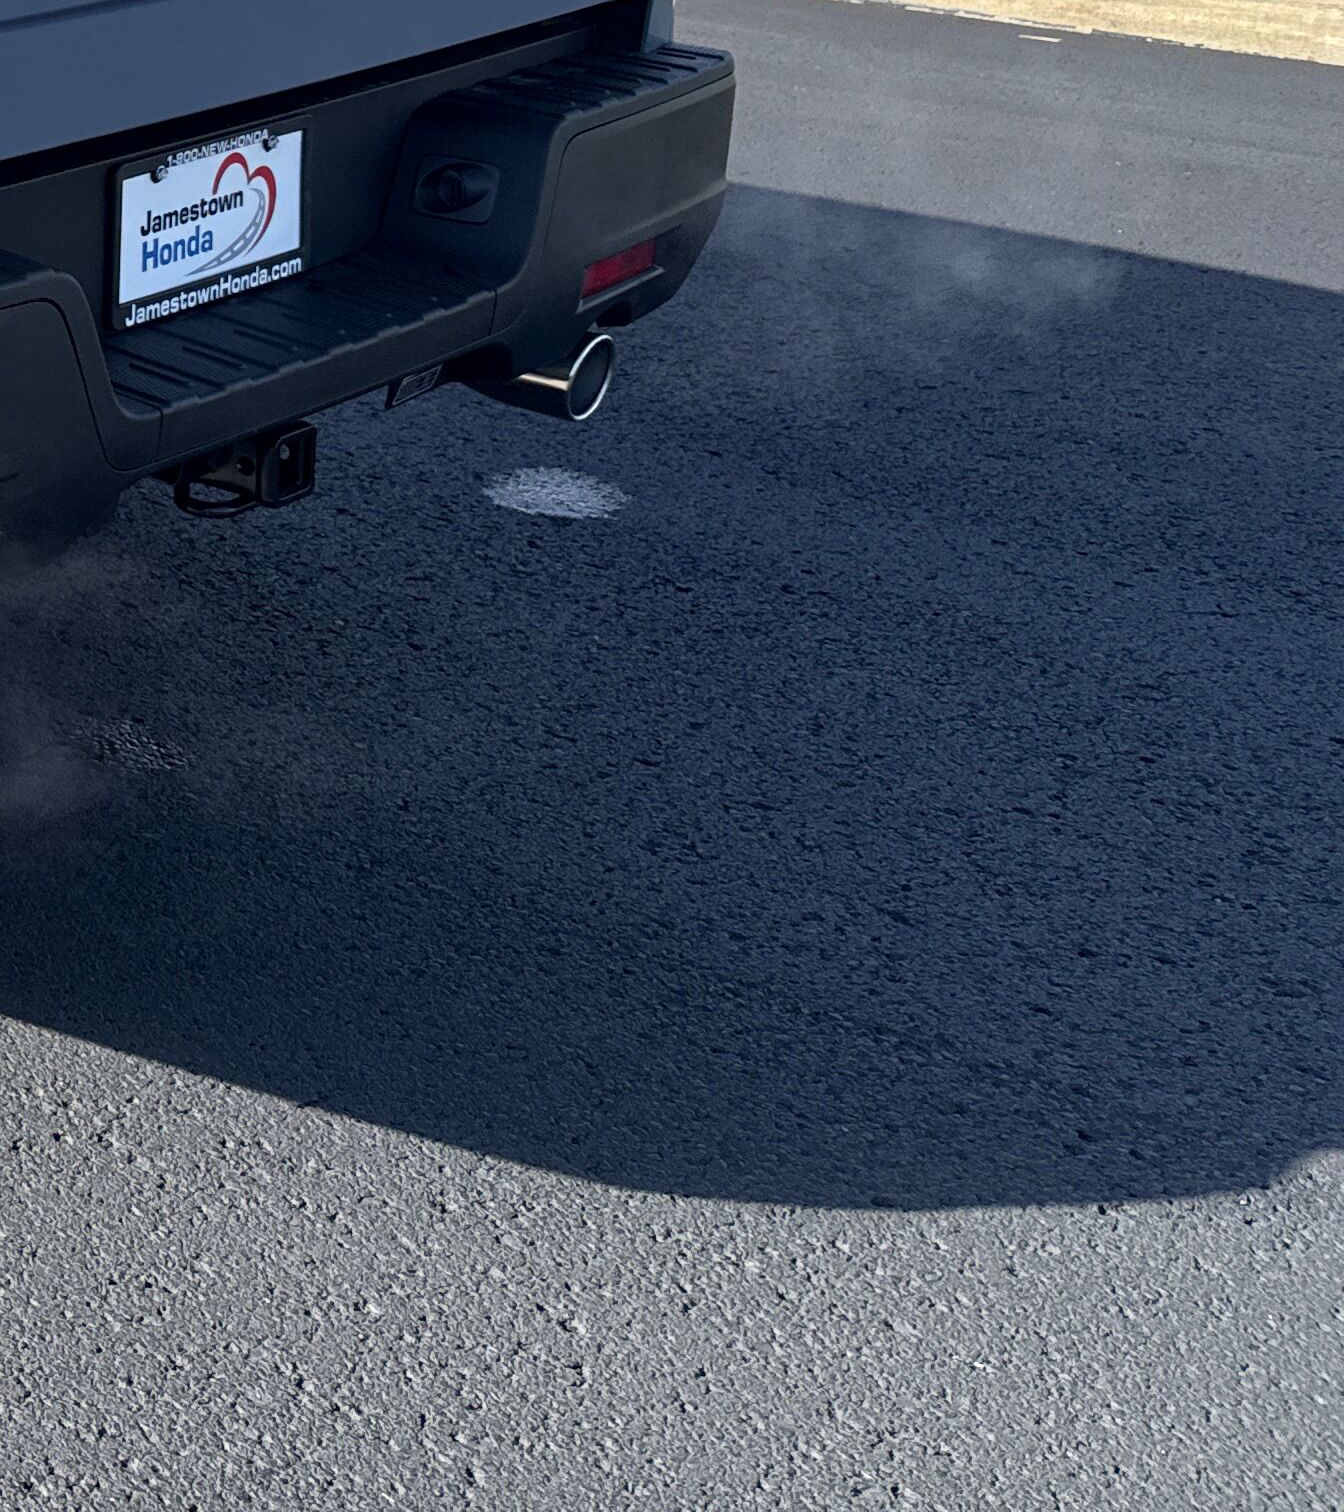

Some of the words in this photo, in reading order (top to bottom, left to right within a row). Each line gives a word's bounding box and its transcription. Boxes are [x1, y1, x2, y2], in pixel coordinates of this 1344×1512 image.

[166, 128, 269, 168] 1-800-NEW-HONDA
[140, 189, 244, 237] Jamestown
[141, 225, 214, 273] Honda
[125, 256, 302, 327] JamestownHonda.com
